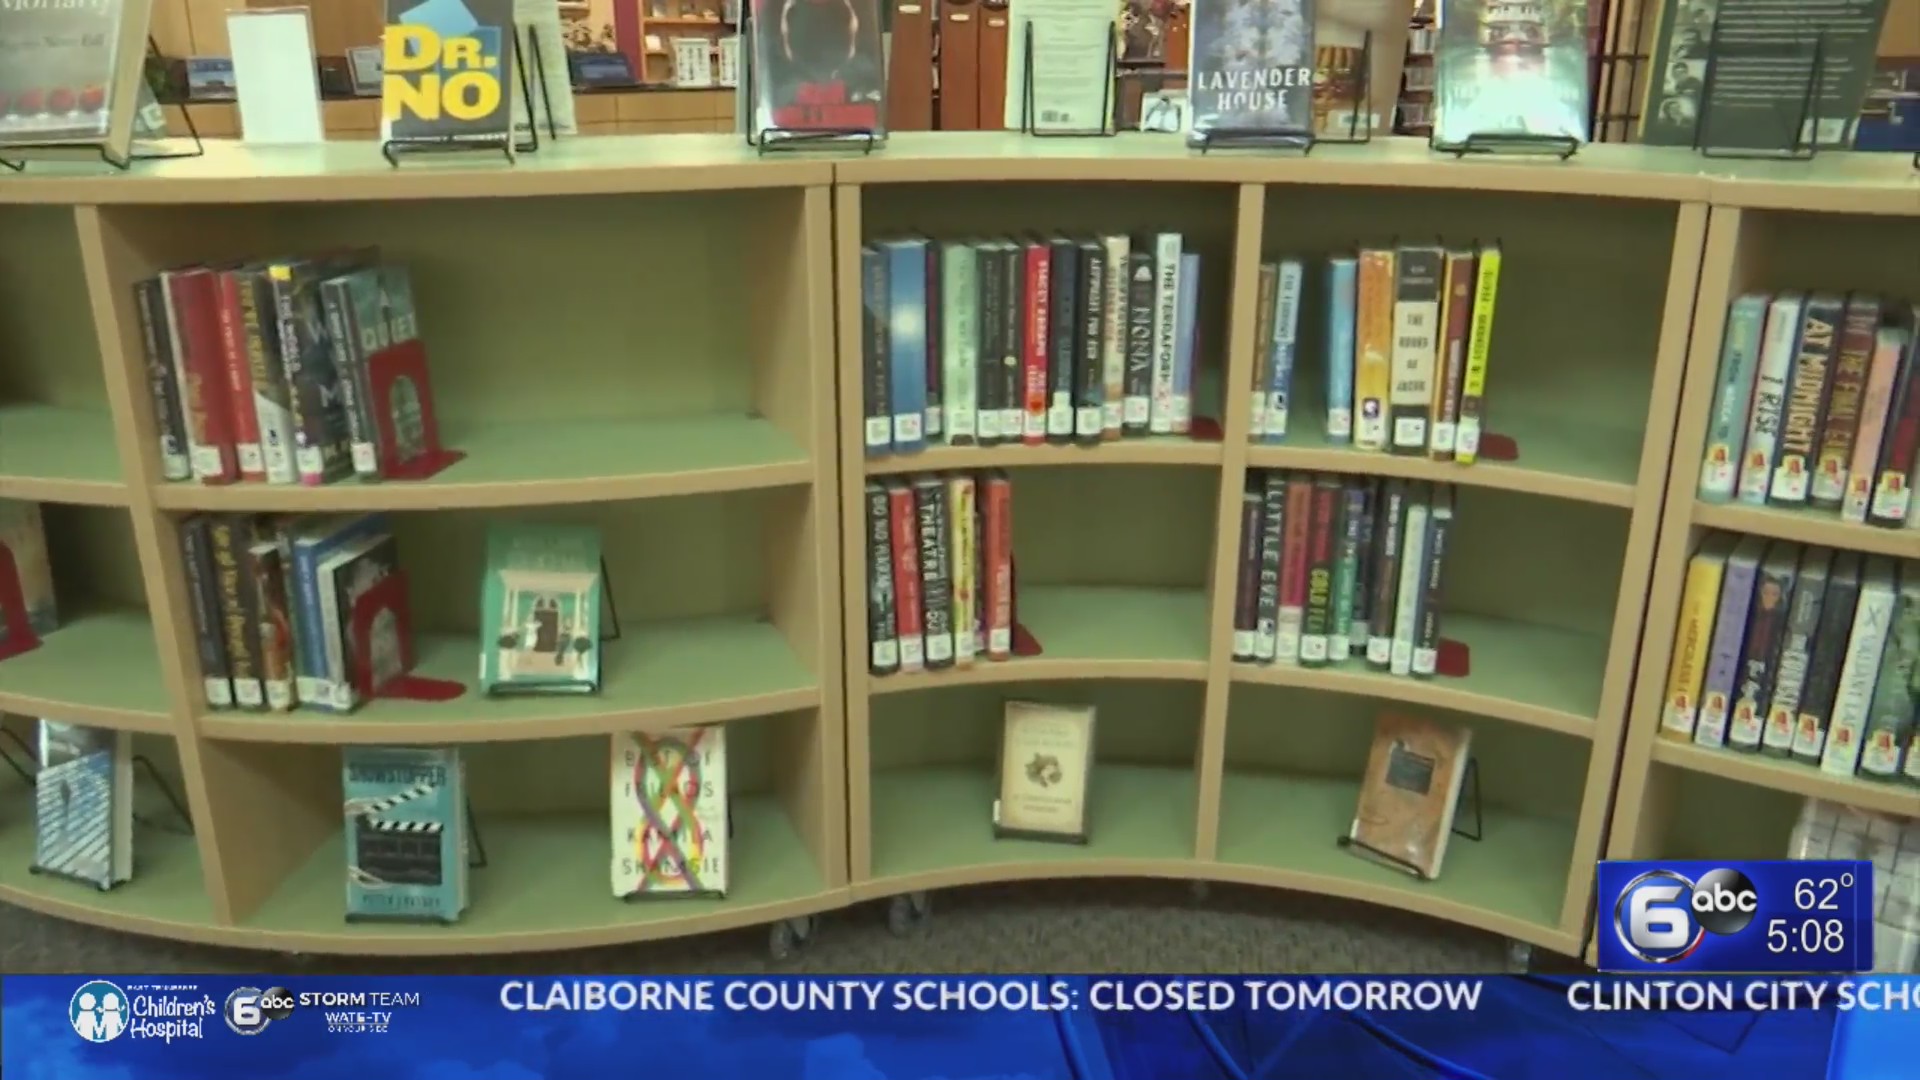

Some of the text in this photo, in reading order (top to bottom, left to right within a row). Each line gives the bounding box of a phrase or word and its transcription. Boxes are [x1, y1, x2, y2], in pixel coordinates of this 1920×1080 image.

[384, 25, 498, 71] DR.
[383, 71, 501, 121] NO
[1198, 67, 1311, 91] LAVENDER
[1217, 89, 1289, 111] HOUSE
[1130, 306, 1151, 374] NONA
[1782, 319, 1833, 453] AT MIDNIGHT
[1259, 490, 1284, 607] LITTLE EVE
